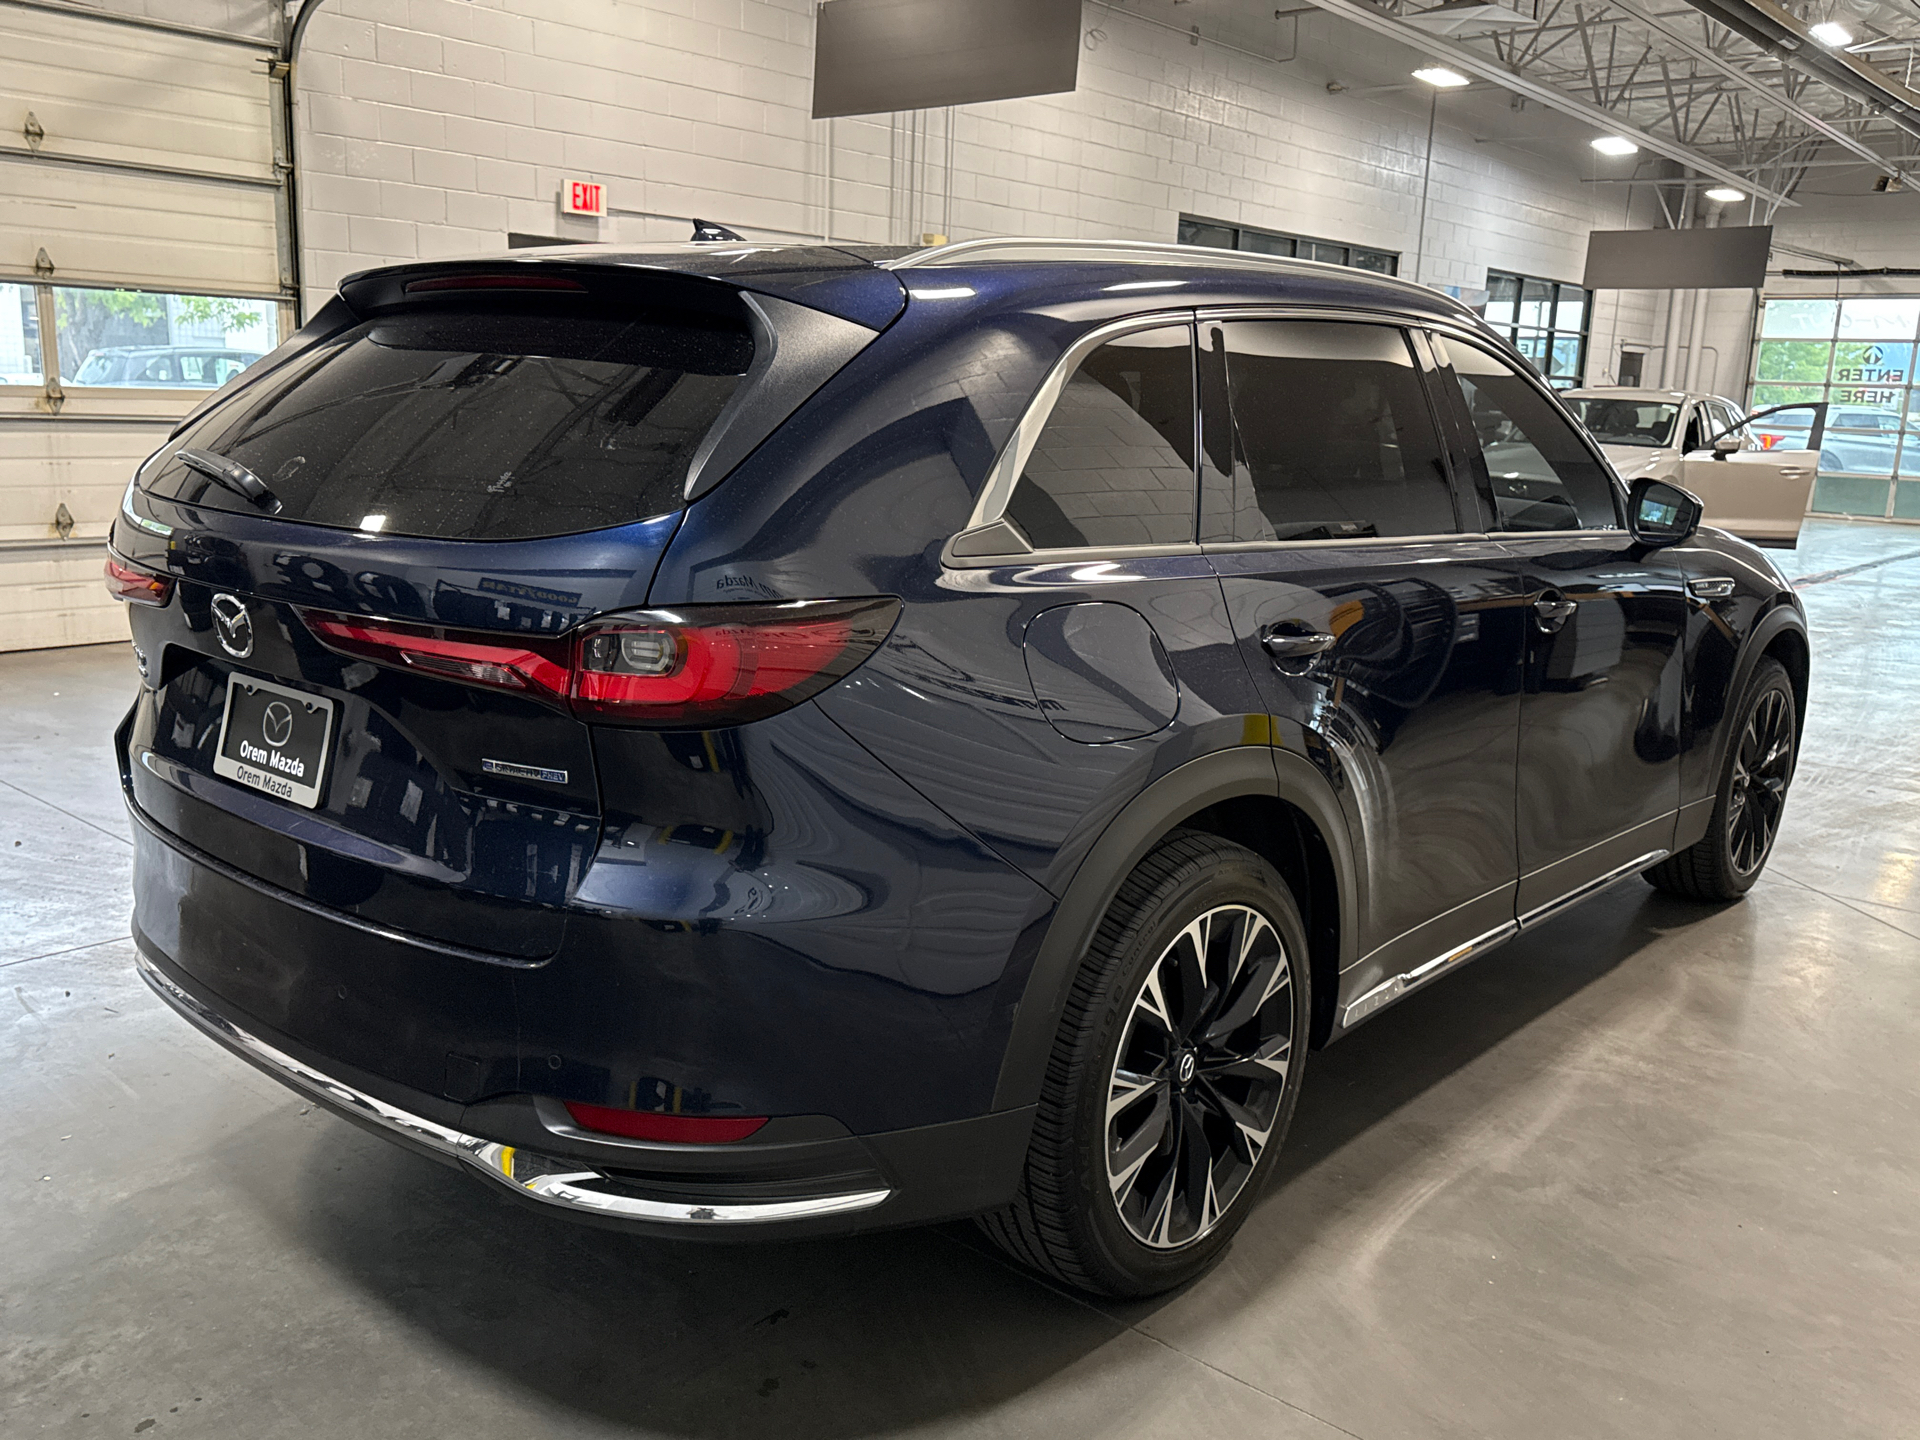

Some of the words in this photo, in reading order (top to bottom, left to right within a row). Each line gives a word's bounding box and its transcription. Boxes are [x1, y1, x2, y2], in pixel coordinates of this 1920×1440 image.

[572, 181, 602, 213] EXIT
[240, 740, 267, 765] Orem
[269, 749, 305, 778] Mazda
[236, 765, 261, 787] Orem
[262, 775, 293, 798] Mazda
